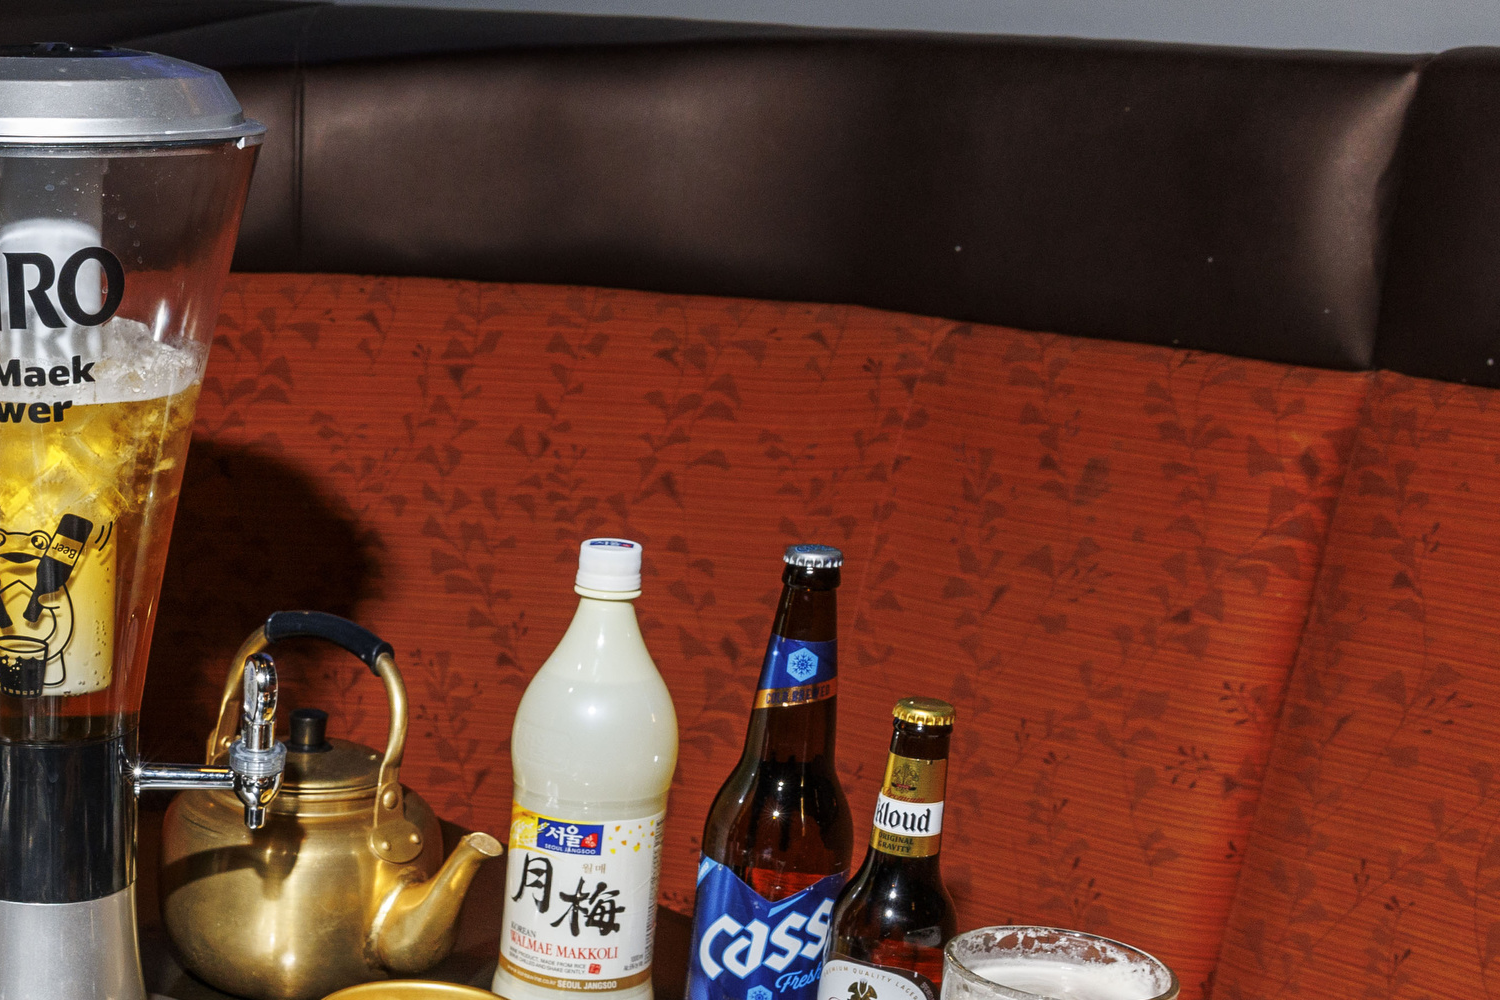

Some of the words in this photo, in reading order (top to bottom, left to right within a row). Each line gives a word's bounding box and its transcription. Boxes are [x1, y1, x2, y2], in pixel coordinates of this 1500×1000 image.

[52, 543, 78, 559] Beer
[766, 691, 788, 704] COLD
[545, 825, 583, 847] 서울
[878, 831, 914, 845] ORIGINAL
[545, 844, 563, 852] SEOUL
[878, 840, 912, 853] GRAVITY
[511, 852, 626, 937] 月梅
[511, 921, 536, 938] KOREAN
[510, 929, 553, 956] WALMAE
[555, 945, 619, 960] MAKKOLI
[557, 979, 582, 990] SEOUL
[583, 980, 617, 990] JANGSOO
[775, 961, 823, 994] Fresh
[823, 966, 849, 978] PREMIUM
[853, 968, 892, 983] QUALITY
[895, 982, 919, 1000] LAGER
